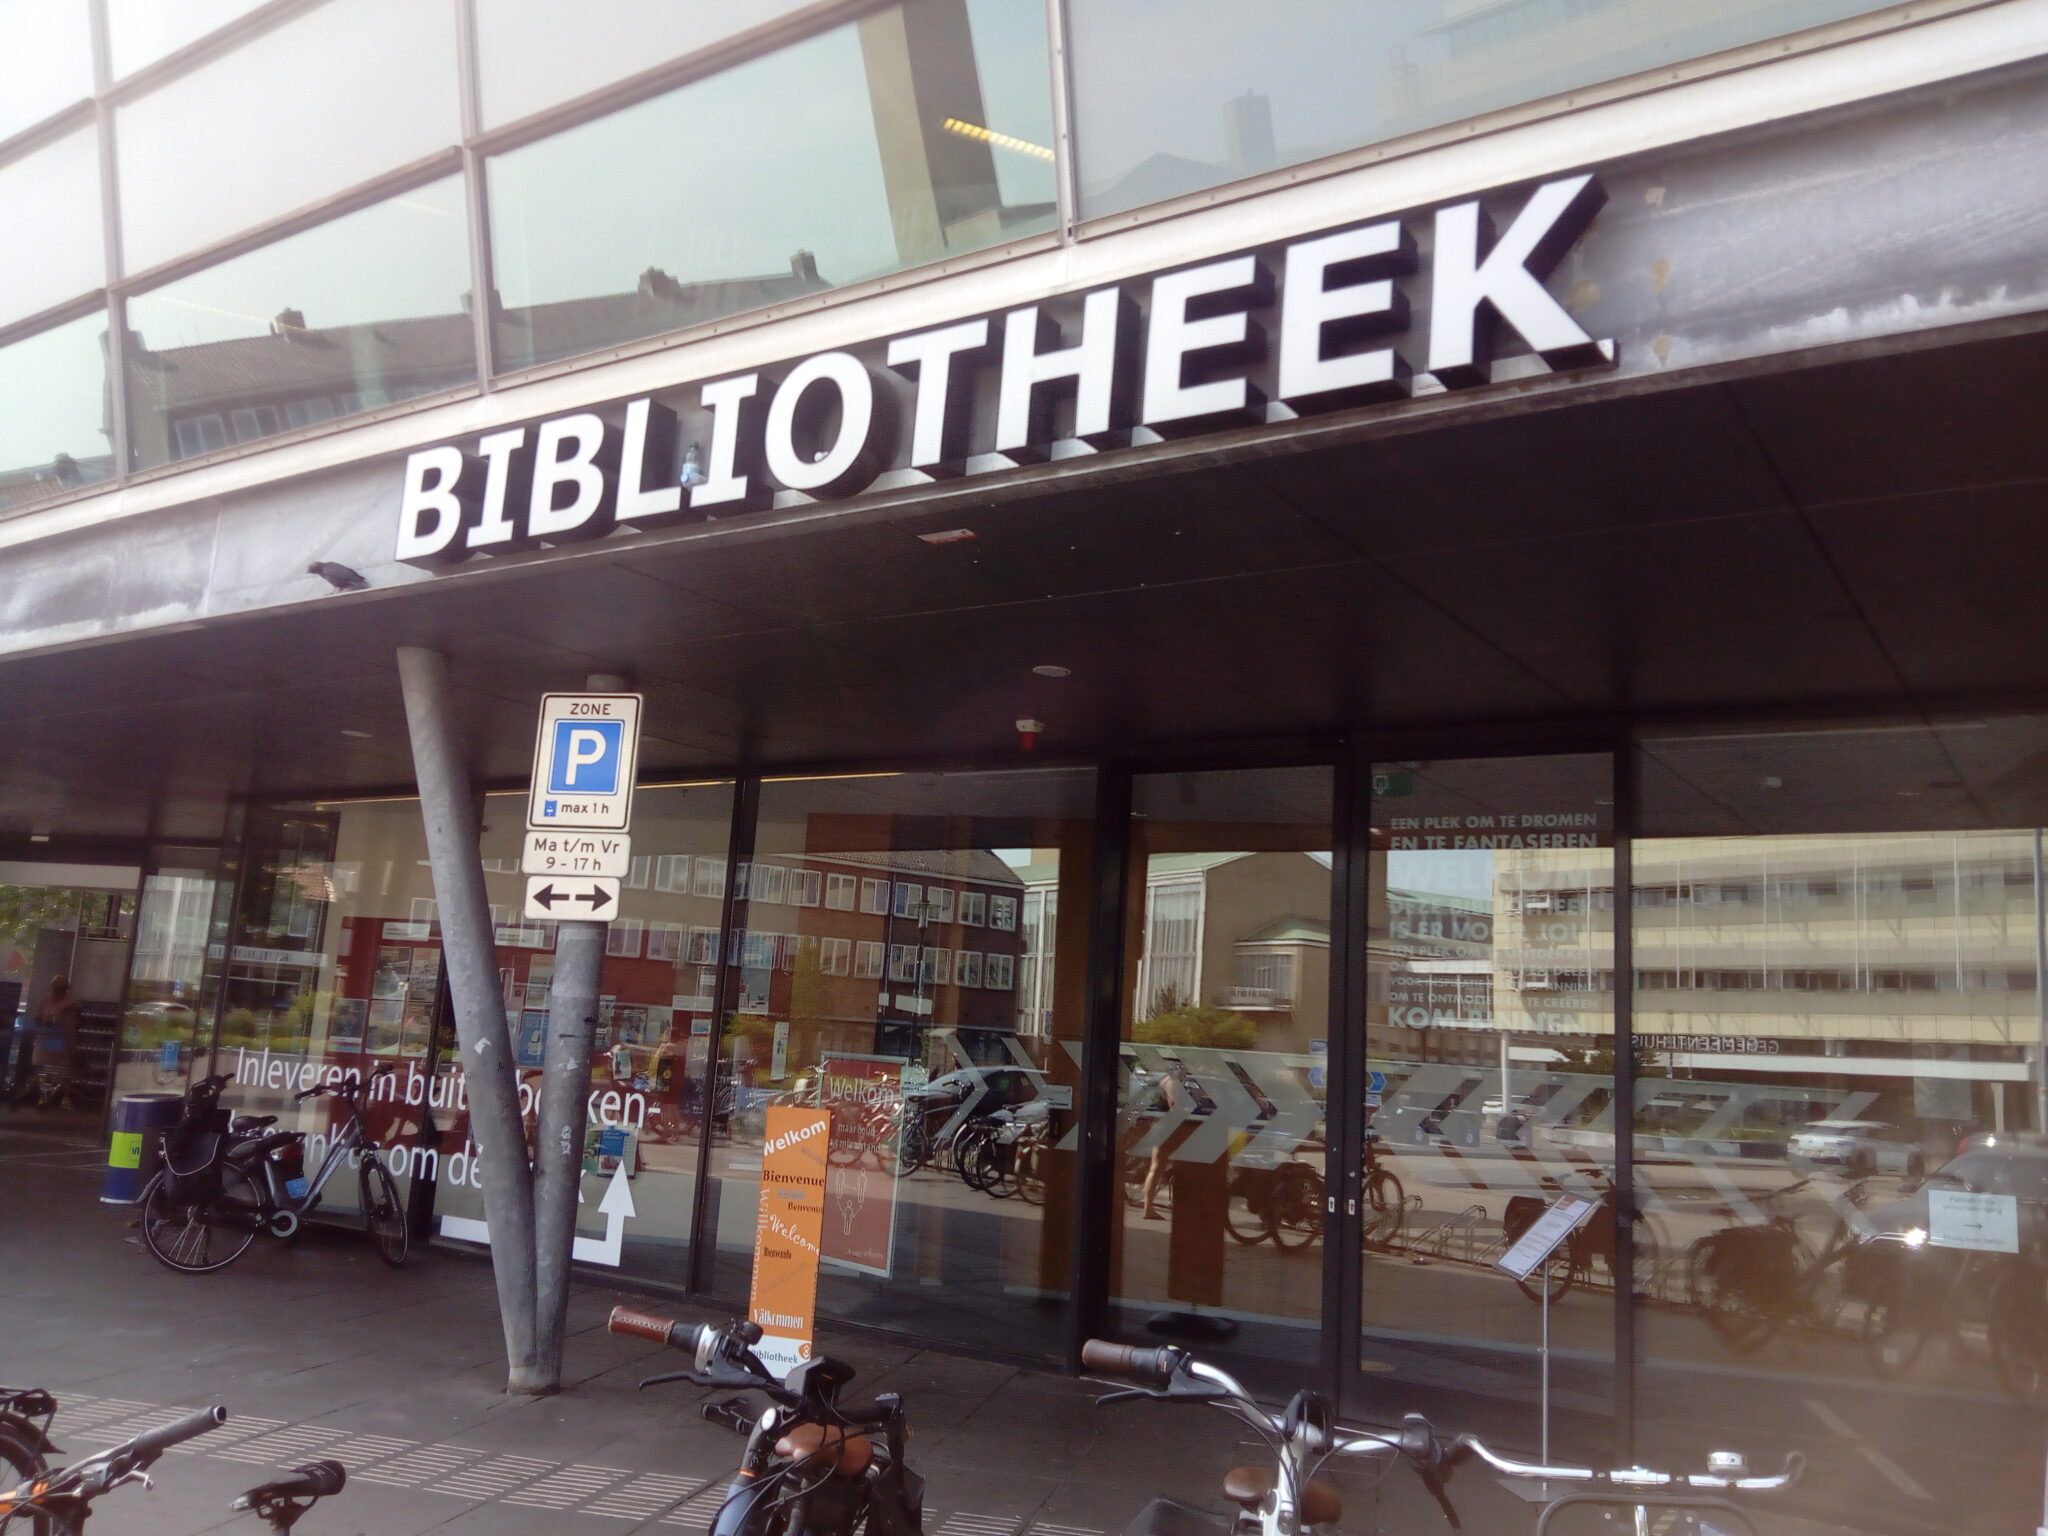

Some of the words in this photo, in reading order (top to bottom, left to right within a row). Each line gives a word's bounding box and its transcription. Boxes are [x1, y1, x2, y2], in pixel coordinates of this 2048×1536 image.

[395, 173, 1596, 562] BIBLIOTHEEK
[570, 703, 611, 715] ZONE
[565, 729, 607, 785] P
[561, 804, 588, 814] max
[593, 803, 597, 814] 1
[602, 803, 609, 815] h
[1391, 817, 1418, 829] EEN
[1424, 816, 1460, 828] PLEK
[1466, 816, 1494, 827] OM
[1499, 815, 1517, 827] TE
[1521, 813, 1597, 827] DROMEN
[534, 837, 558, 852] Ma
[563, 838, 595, 853] t/m
[600, 839, 620, 854] Vr
[1391, 836, 1418, 849] EN
[1425, 836, 1447, 849] TE
[1453, 833, 1598, 849] FANTASEREN
[546, 857, 556, 869] 9
[574, 858, 588, 870] 17
[593, 858, 601, 870] h
[1387, 1006, 1457, 1029] KOM
[235, 1047, 361, 1099] Inleveren
[368, 1059, 396, 1102] in
[388, 1144, 438, 1182] om
[763, 1169, 825, 1187] Bienvenue
